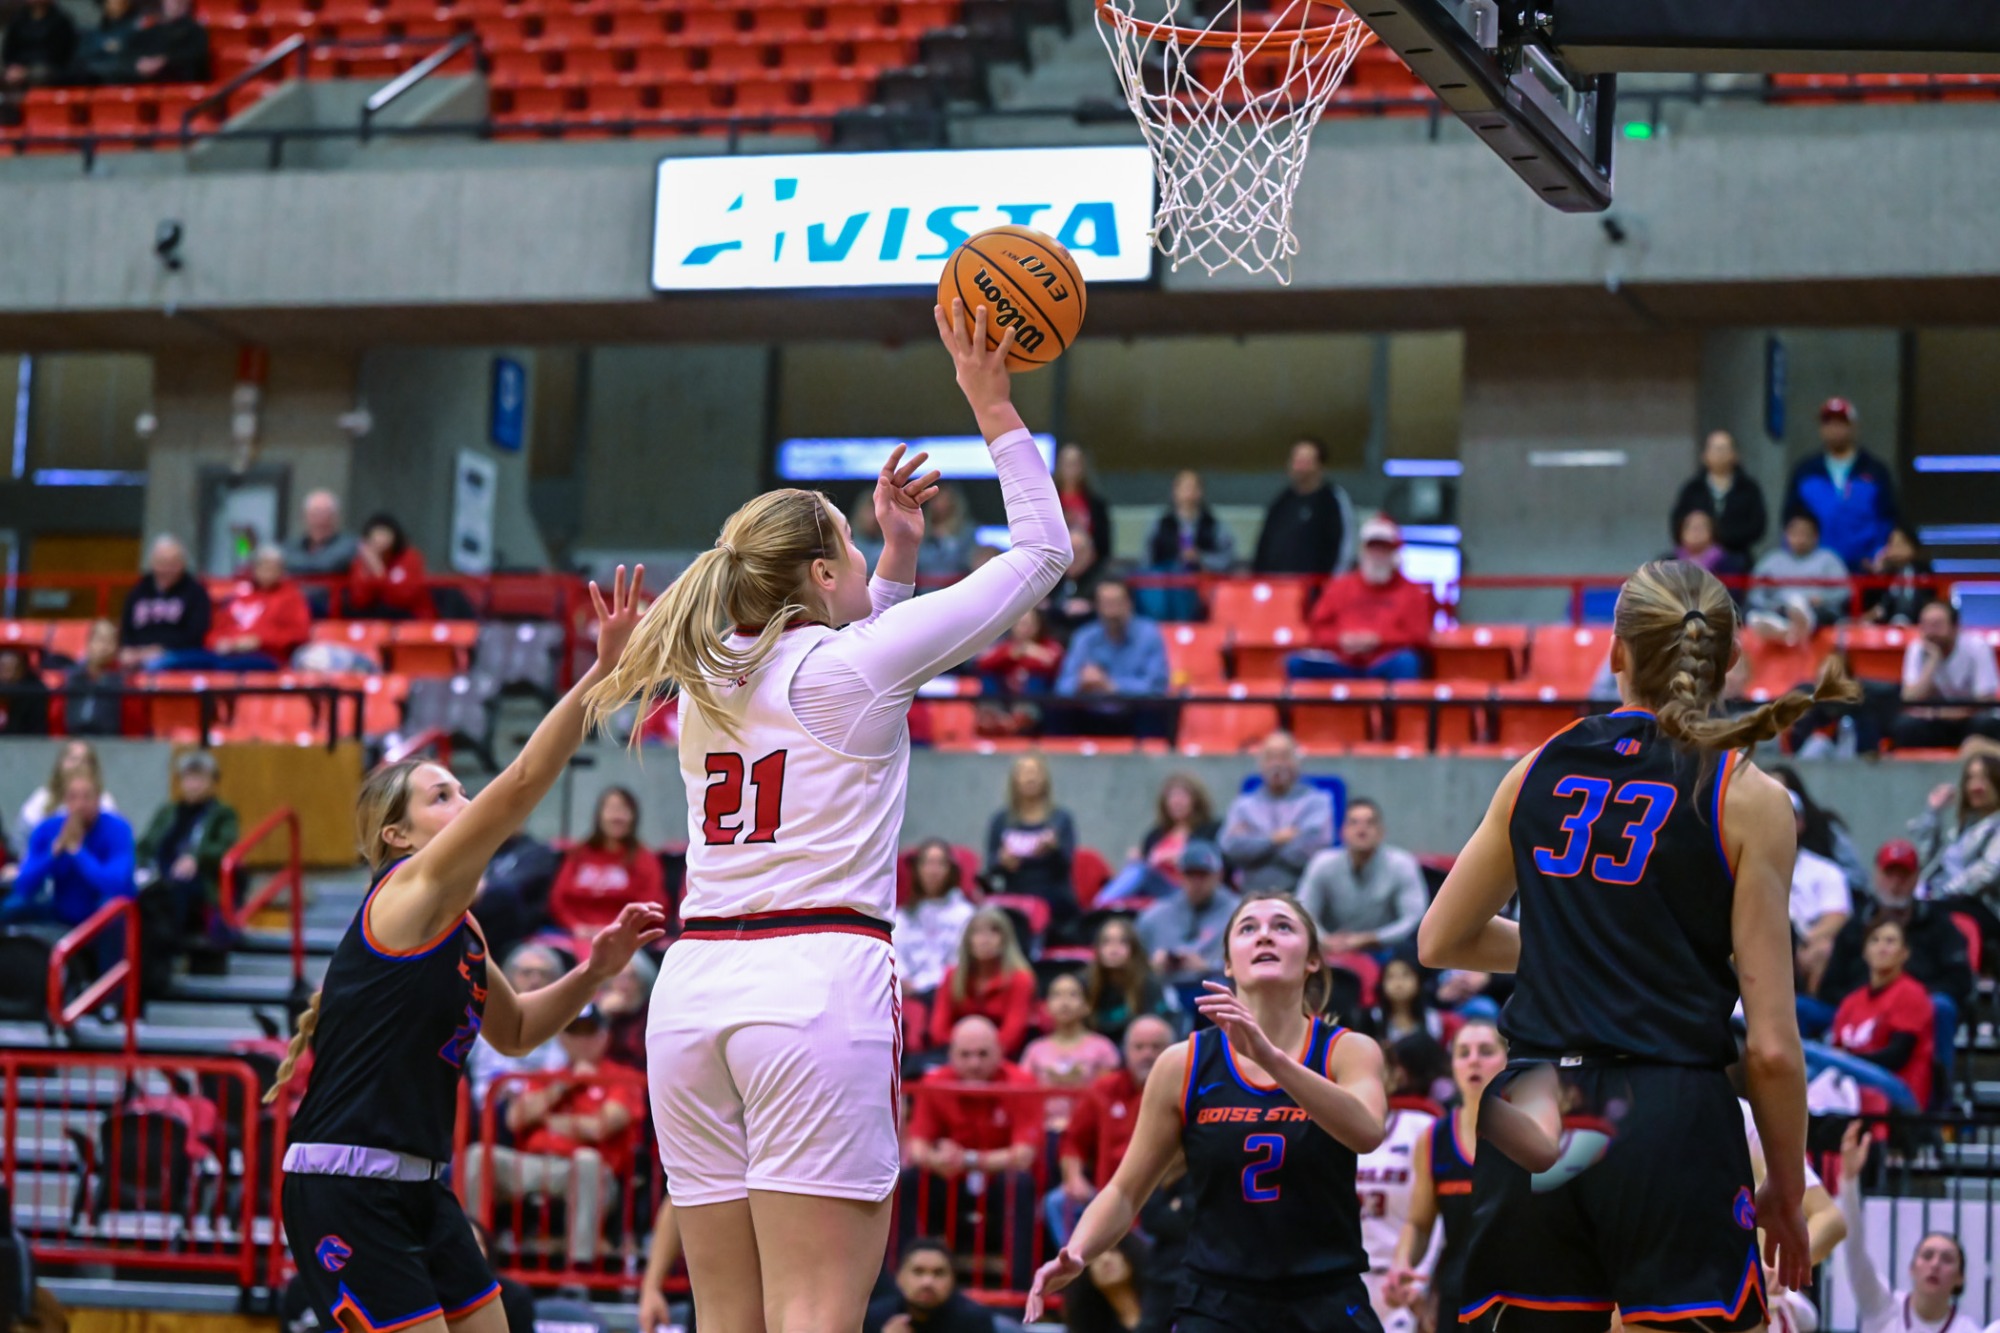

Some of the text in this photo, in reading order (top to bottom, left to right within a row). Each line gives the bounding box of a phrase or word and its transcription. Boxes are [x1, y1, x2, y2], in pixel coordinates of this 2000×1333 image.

[680, 178, 1120, 265] AVISTA
[973, 267, 1045, 354] Wilson
[1017, 255, 1069, 302] EVO
[702, 749, 788, 846] 21
[1533, 774, 1679, 885] 33
[1196, 1105, 1312, 1124] BOISE STA
[1241, 1133, 1286, 1202] 2
